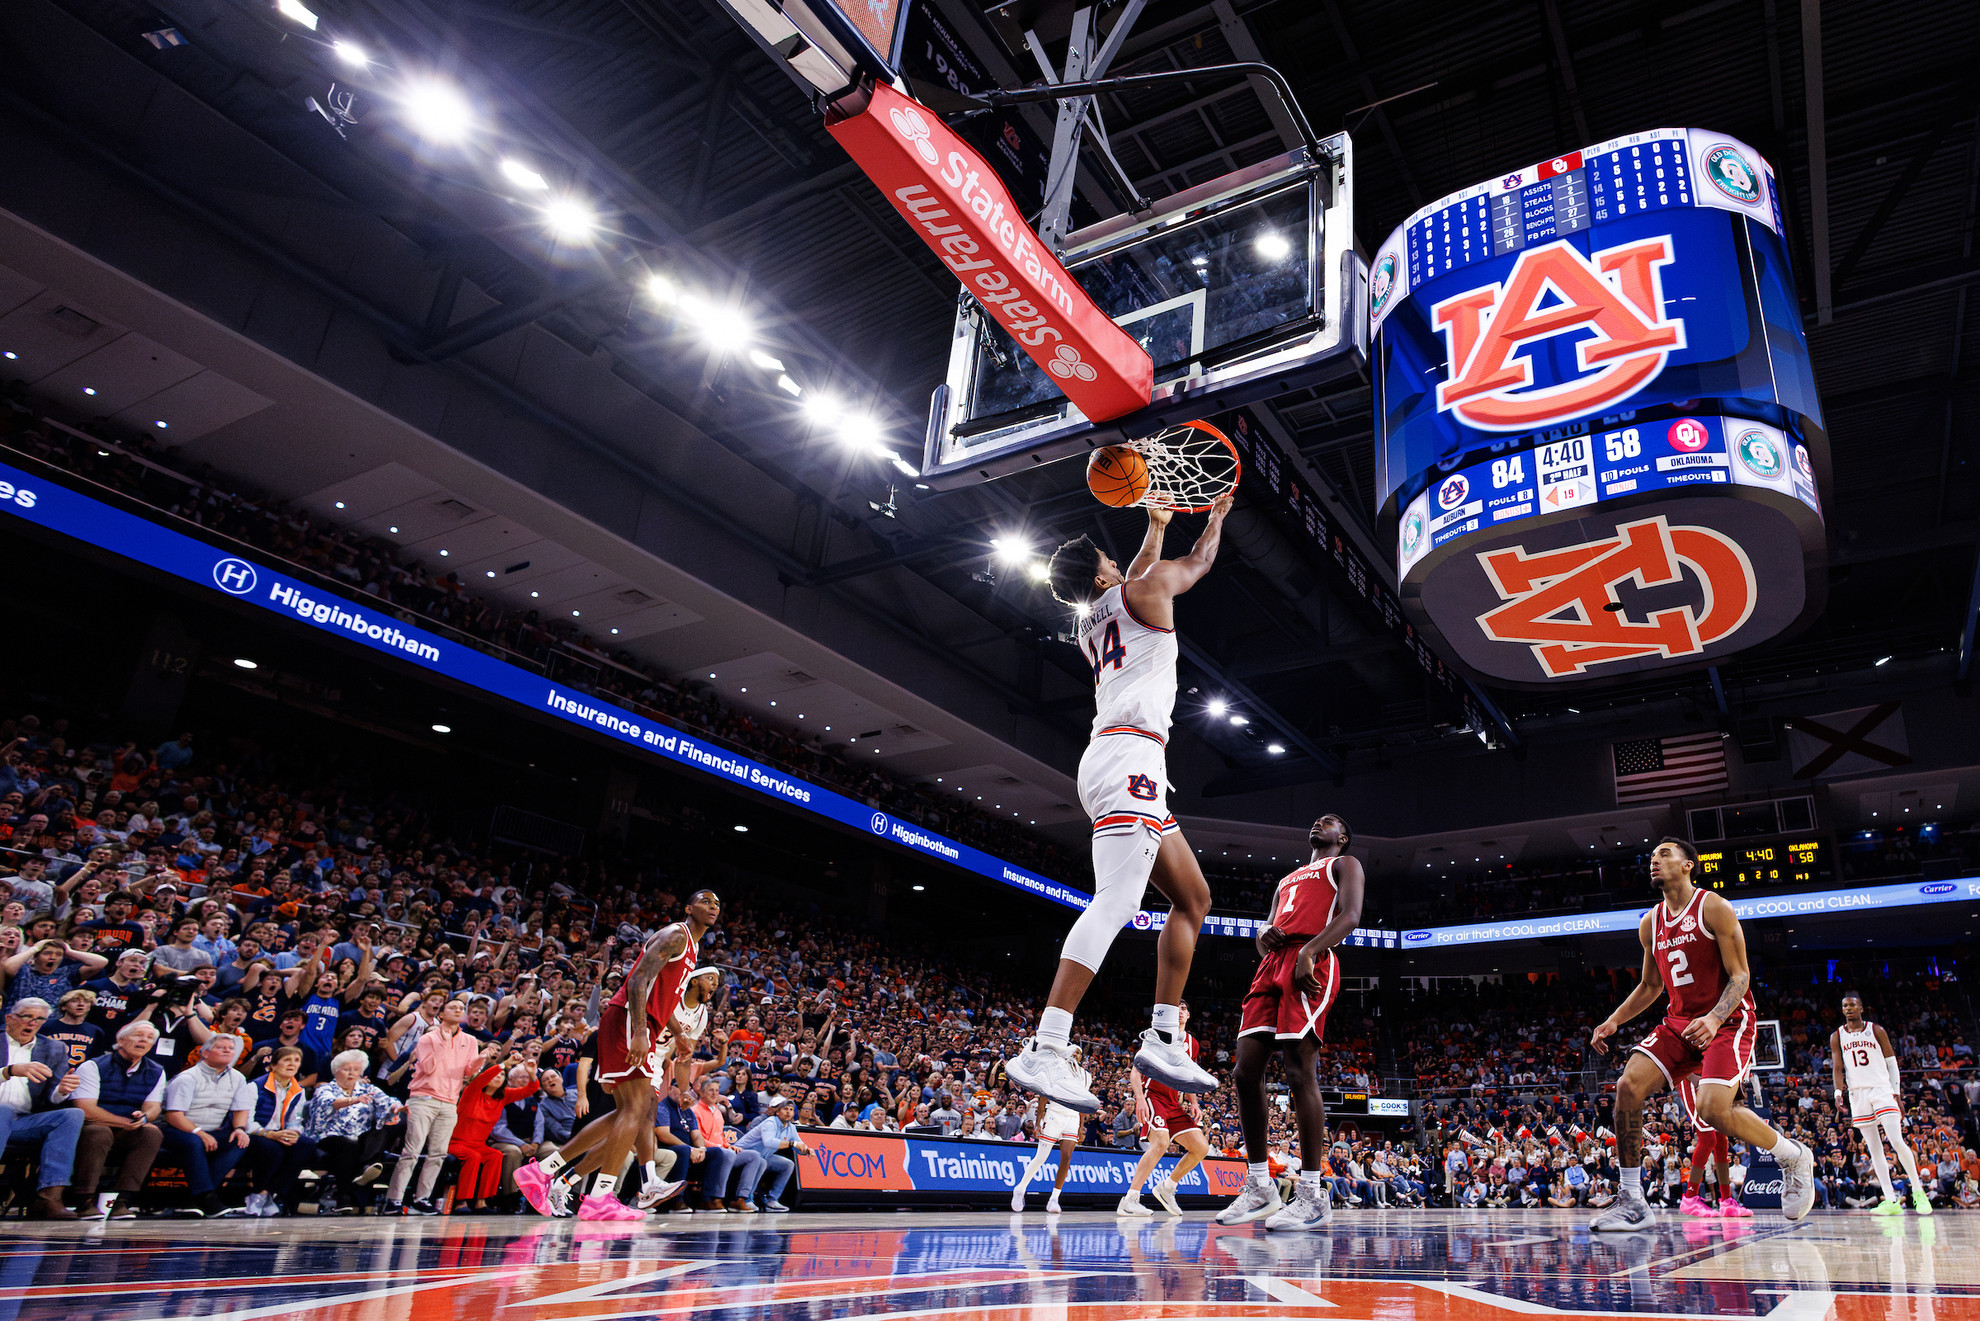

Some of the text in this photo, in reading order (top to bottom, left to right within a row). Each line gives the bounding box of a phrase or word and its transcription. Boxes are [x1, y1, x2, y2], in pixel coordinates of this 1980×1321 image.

[926, 40, 969, 96] 1980
[1608, 141, 1618, 149] PTS
[1711, 151, 1723, 162] OLD
[1523, 183, 1551, 197] ASSISTS
[1524, 194, 1552, 208] STEALS
[1525, 205, 1553, 219] BLOCKS
[1526, 219, 1544, 230] BENCH
[1545, 216, 1554, 224] PTS
[1528, 227, 1556, 241] FB PTS
[1604, 428, 1641, 462] 58
[1543, 439, 1585, 468] 4:40
[1670, 456, 1714, 467] OKLAHOMA
[1491, 456, 1525, 489] 84
[1562, 469, 1582, 480] HALF
[1619, 464, 1650, 477] FOULS
[1666, 473, 1711, 483] TIMEOUTS
[1564, 489, 1574, 499] 19
[1608, 480, 1636, 494] BONUS
[1489, 495, 1516, 508] FOULS
[1443, 508, 1466, 525] AUBURN
[1495, 508, 1520, 520] BONUS
[1435, 525, 1466, 544] TIMEOUTS
[269, 581, 440, 662] Higginbotham
[547, 689, 811, 802] Insurance and Financial Services
[892, 823, 959, 859] Higginbotham
[1788, 842, 1818, 851] OKLAHOMA
[1698, 853, 1722, 861] UBURN
[1746, 849, 1773, 861] 4:40
[1799, 852, 1814, 863] 58
[1704, 862, 1718, 872] 84
[1756, 871, 1761, 879] 2
[1770, 870, 1778, 878] 10
[1003, 867, 1092, 909] Insurance and Financi
[1923, 884, 1953, 894] Carrier
[1282, 885, 1298, 914] 1
[1734, 894, 1882, 917] at's COOL and CLEAN...
[1437, 919, 1610, 942] For air that's COOL and CLEAN...
[1657, 933, 1697, 950] OKLAHOMA
[1667, 949, 1695, 987] 2
[316, 1018, 326, 1031] 3
[1843, 1041, 1876, 1053] AUBURN
[1852, 1050, 1869, 1067] 13
[816, 1149, 886, 1178] VCOM
[921, 1150, 1016, 1187] Training
[1215, 1166, 1247, 1188] VCOM
[1744, 1179, 1784, 1194] Coca-Col
